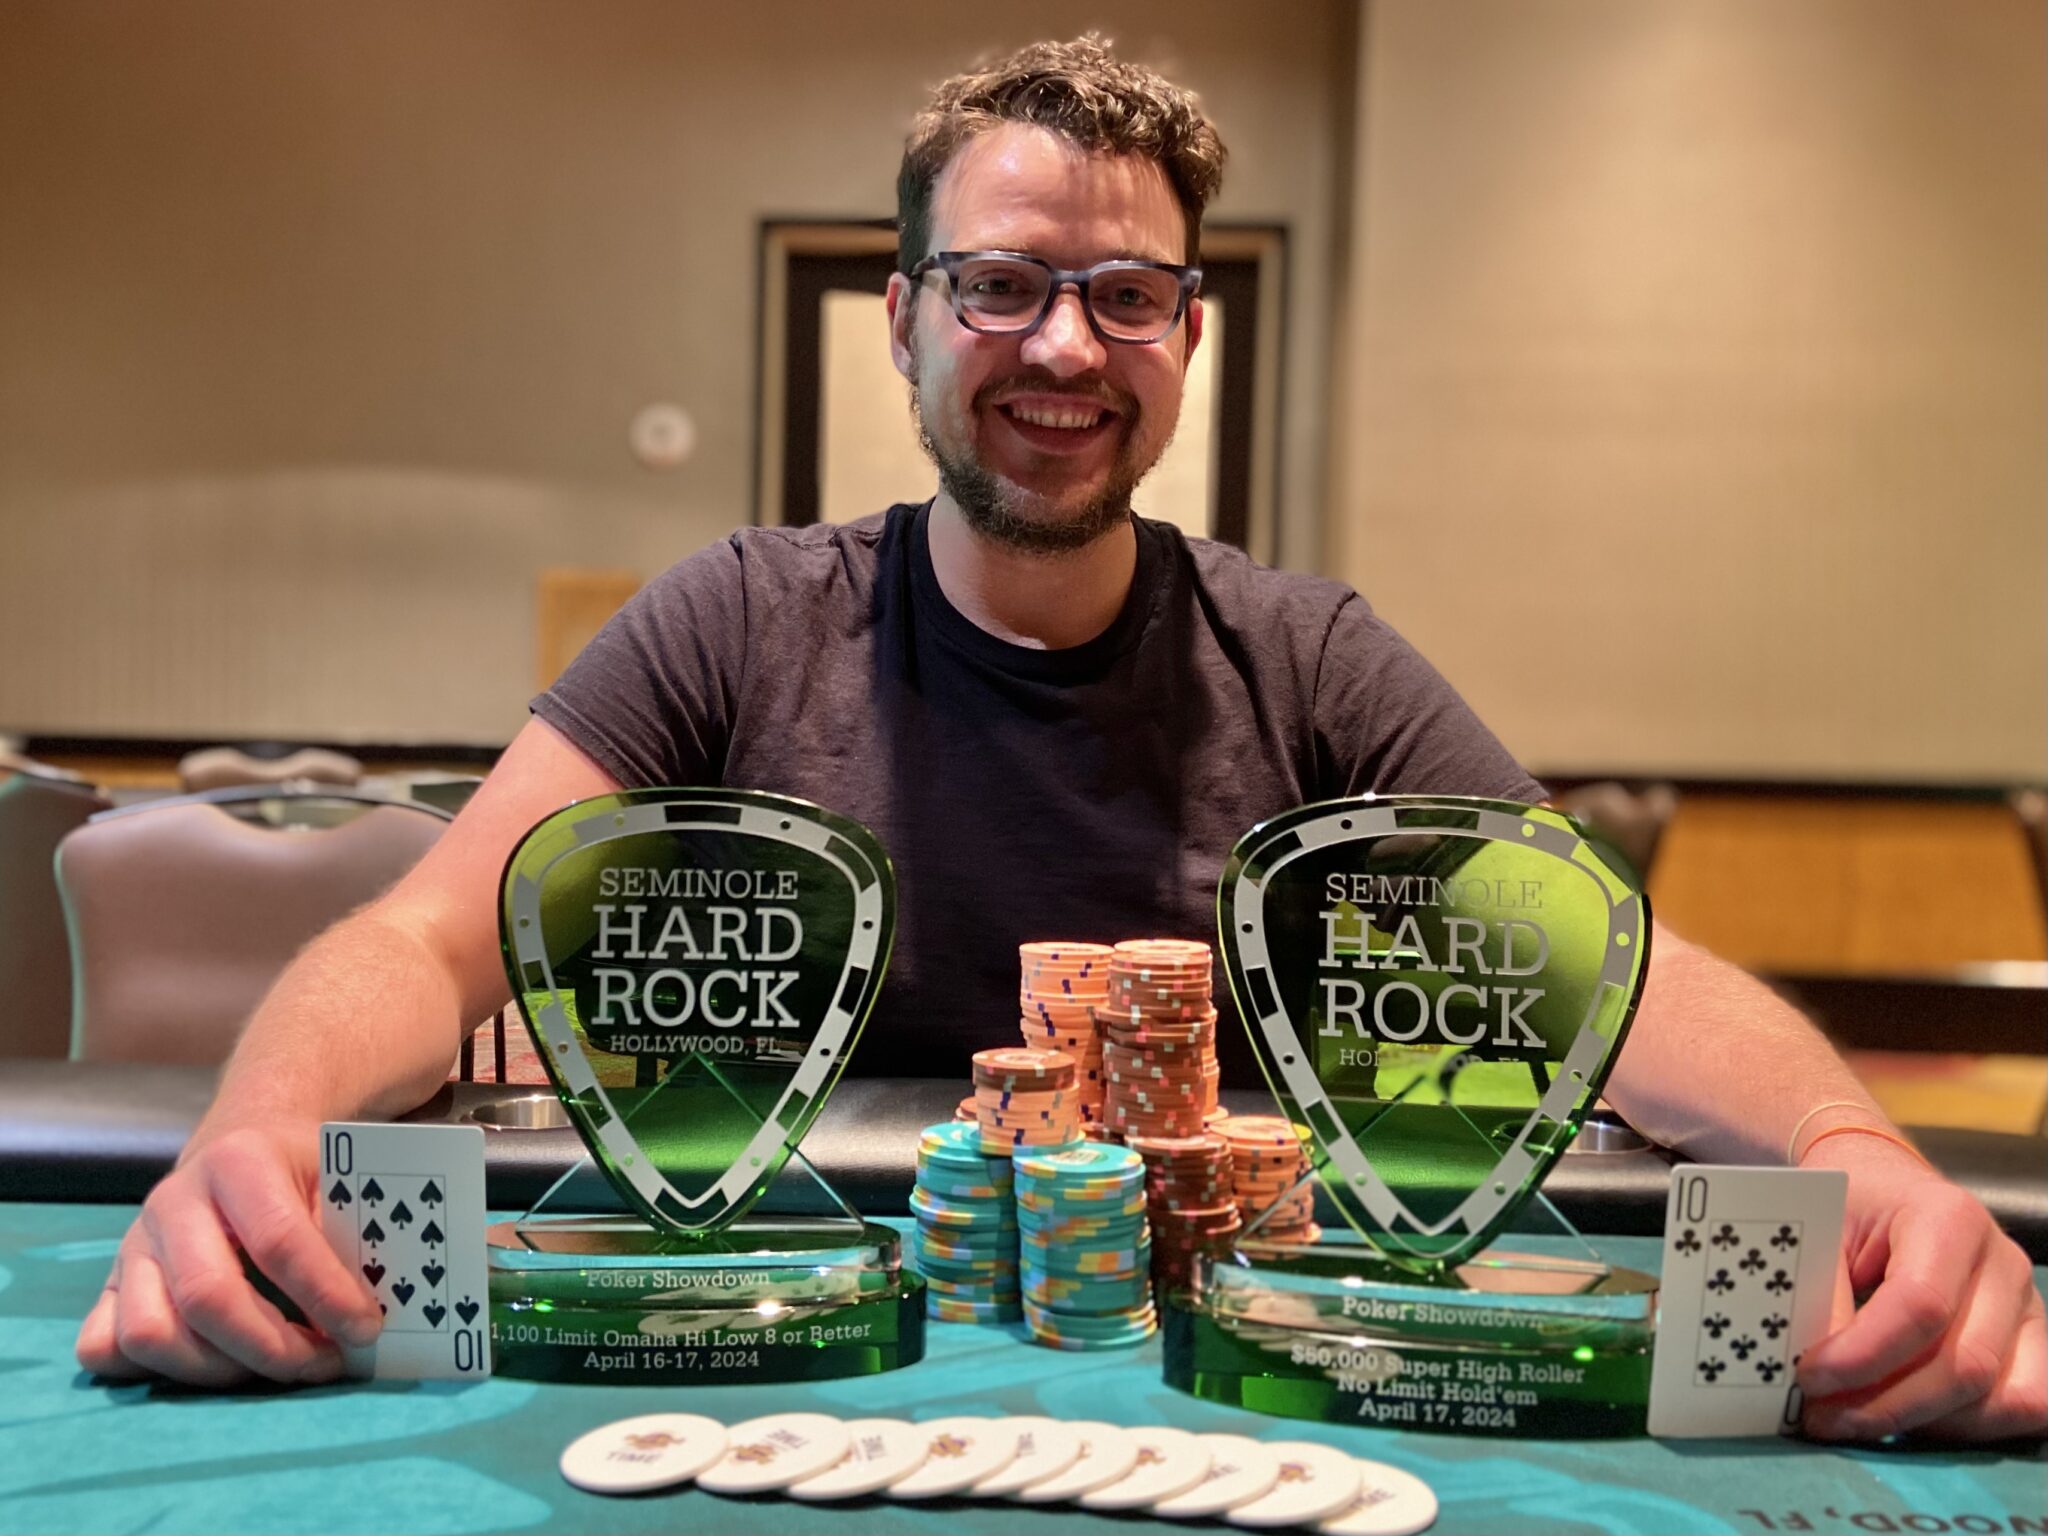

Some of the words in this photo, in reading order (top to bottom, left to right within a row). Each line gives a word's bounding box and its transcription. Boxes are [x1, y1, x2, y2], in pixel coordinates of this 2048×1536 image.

[599, 867, 799, 900] SEMINOLE
[1325, 872, 1543, 909] SEMINOLE
[591, 904, 803, 962] HARD
[1318, 911, 1550, 976] HARD
[591, 968, 801, 1028] ROCK
[1318, 978, 1547, 1049] ROCK
[609, 1035, 749, 1056] HOLLYWOOD,
[325, 1131, 353, 1176] 10
[1676, 1176, 1708, 1223] 10
[587, 1269, 646, 1289] Poker
[652, 1269, 771, 1289] Showdown
[1342, 1295, 1408, 1322] Poker
[1413, 1304, 1543, 1330] Showdown
[454, 1329, 483, 1372] 10
[544, 1327, 597, 1347] Limit
[603, 1329, 681, 1348] Omaha
[684, 1330, 708, 1347] Hi
[713, 1329, 760, 1347] Low
[764, 1328, 777, 1346] 8
[782, 1330, 803, 1345] or
[809, 1323, 872, 1344] Better
[584, 1350, 636, 1371] April
[642, 1350, 703, 1373] 16-17,
[709, 1350, 760, 1369] 2024
[1384, 1353, 1450, 1381] Super
[1457, 1360, 1514, 1384] High
[1519, 1362, 1585, 1385] Roller
[1337, 1375, 1370, 1395] No
[1375, 1377, 1436, 1400] Limit
[1441, 1382, 1538, 1406] Hold'em
[1358, 1398, 1418, 1423] April
[1422, 1403, 1456, 1426] 17,
[1461, 1406, 1517, 1428] 2024
